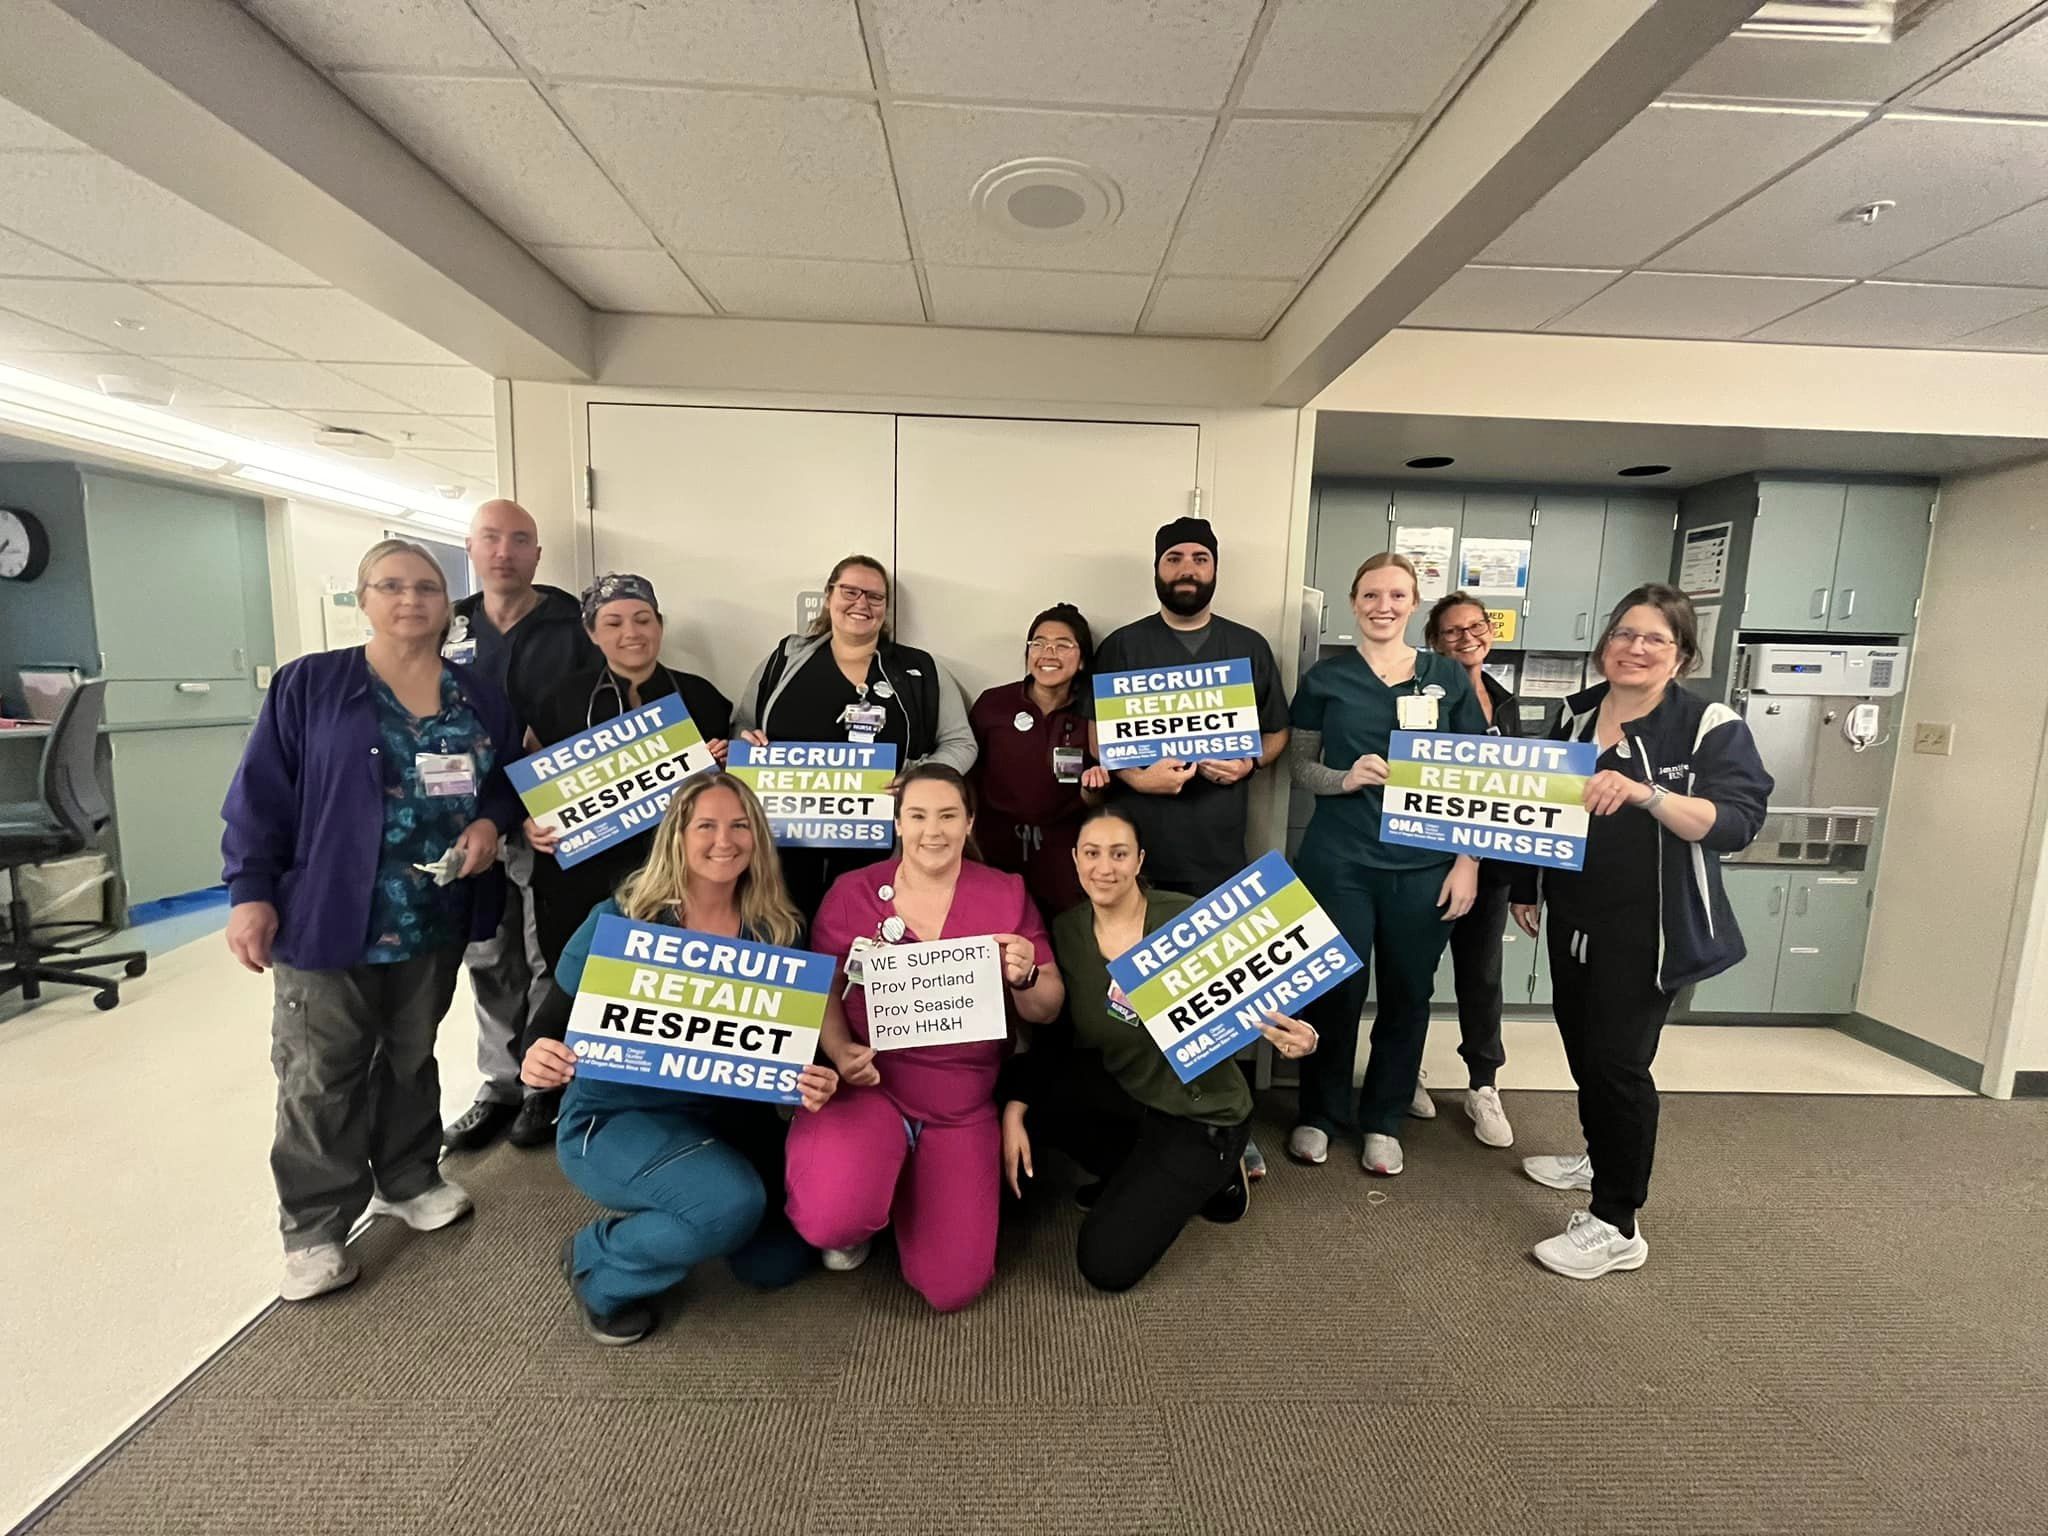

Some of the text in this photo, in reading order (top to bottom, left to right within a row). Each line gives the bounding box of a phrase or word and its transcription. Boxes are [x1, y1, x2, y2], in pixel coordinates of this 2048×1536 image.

[805, 597, 818, 608] DO
[1113, 666, 1231, 695] RECRUIT
[1125, 690, 1224, 715] RETAIN
[1116, 712, 1238, 739] RESPECT
[531, 706, 663, 780] RECRUIT
[749, 746, 875, 766] RECRUIT
[1106, 744, 1138, 758] ONA
[1161, 734, 1254, 757] NURSES
[1412, 738, 1567, 770] RECRUIT
[556, 734, 670, 799] RETAIN
[757, 771, 863, 791] RETAIN
[1420, 766, 1548, 799] RETAIN
[557, 752, 691, 828] RESPECT
[763, 795, 874, 815] ESPECT
[559, 829, 598, 853] ONA
[619, 787, 681, 830] NUR
[1404, 792, 1562, 829] RESPECT
[787, 823, 885, 840] NURSES
[1389, 818, 1424, 834] ONA
[1452, 827, 1574, 860] NURSES
[1131, 870, 1268, 977] RECRUIT
[623, 929, 807, 985] RECRUIT
[871, 945, 991, 971] WE SUPPORT:
[1161, 906, 1281, 997] RETAIN
[629, 968, 783, 1018] RETAIN
[872, 971, 974, 995] Prov Portland
[1167, 925, 1310, 1033] RESPECT
[874, 995, 974, 1018] Prov Seaside
[1176, 1033, 1216, 1063] ONA
[1235, 946, 1347, 1031] NURSES
[600, 1003, 793, 1055] RESPECT
[876, 1016, 963, 1038] Prov HH&H
[573, 1039, 801, 1092] ONA NURSES
